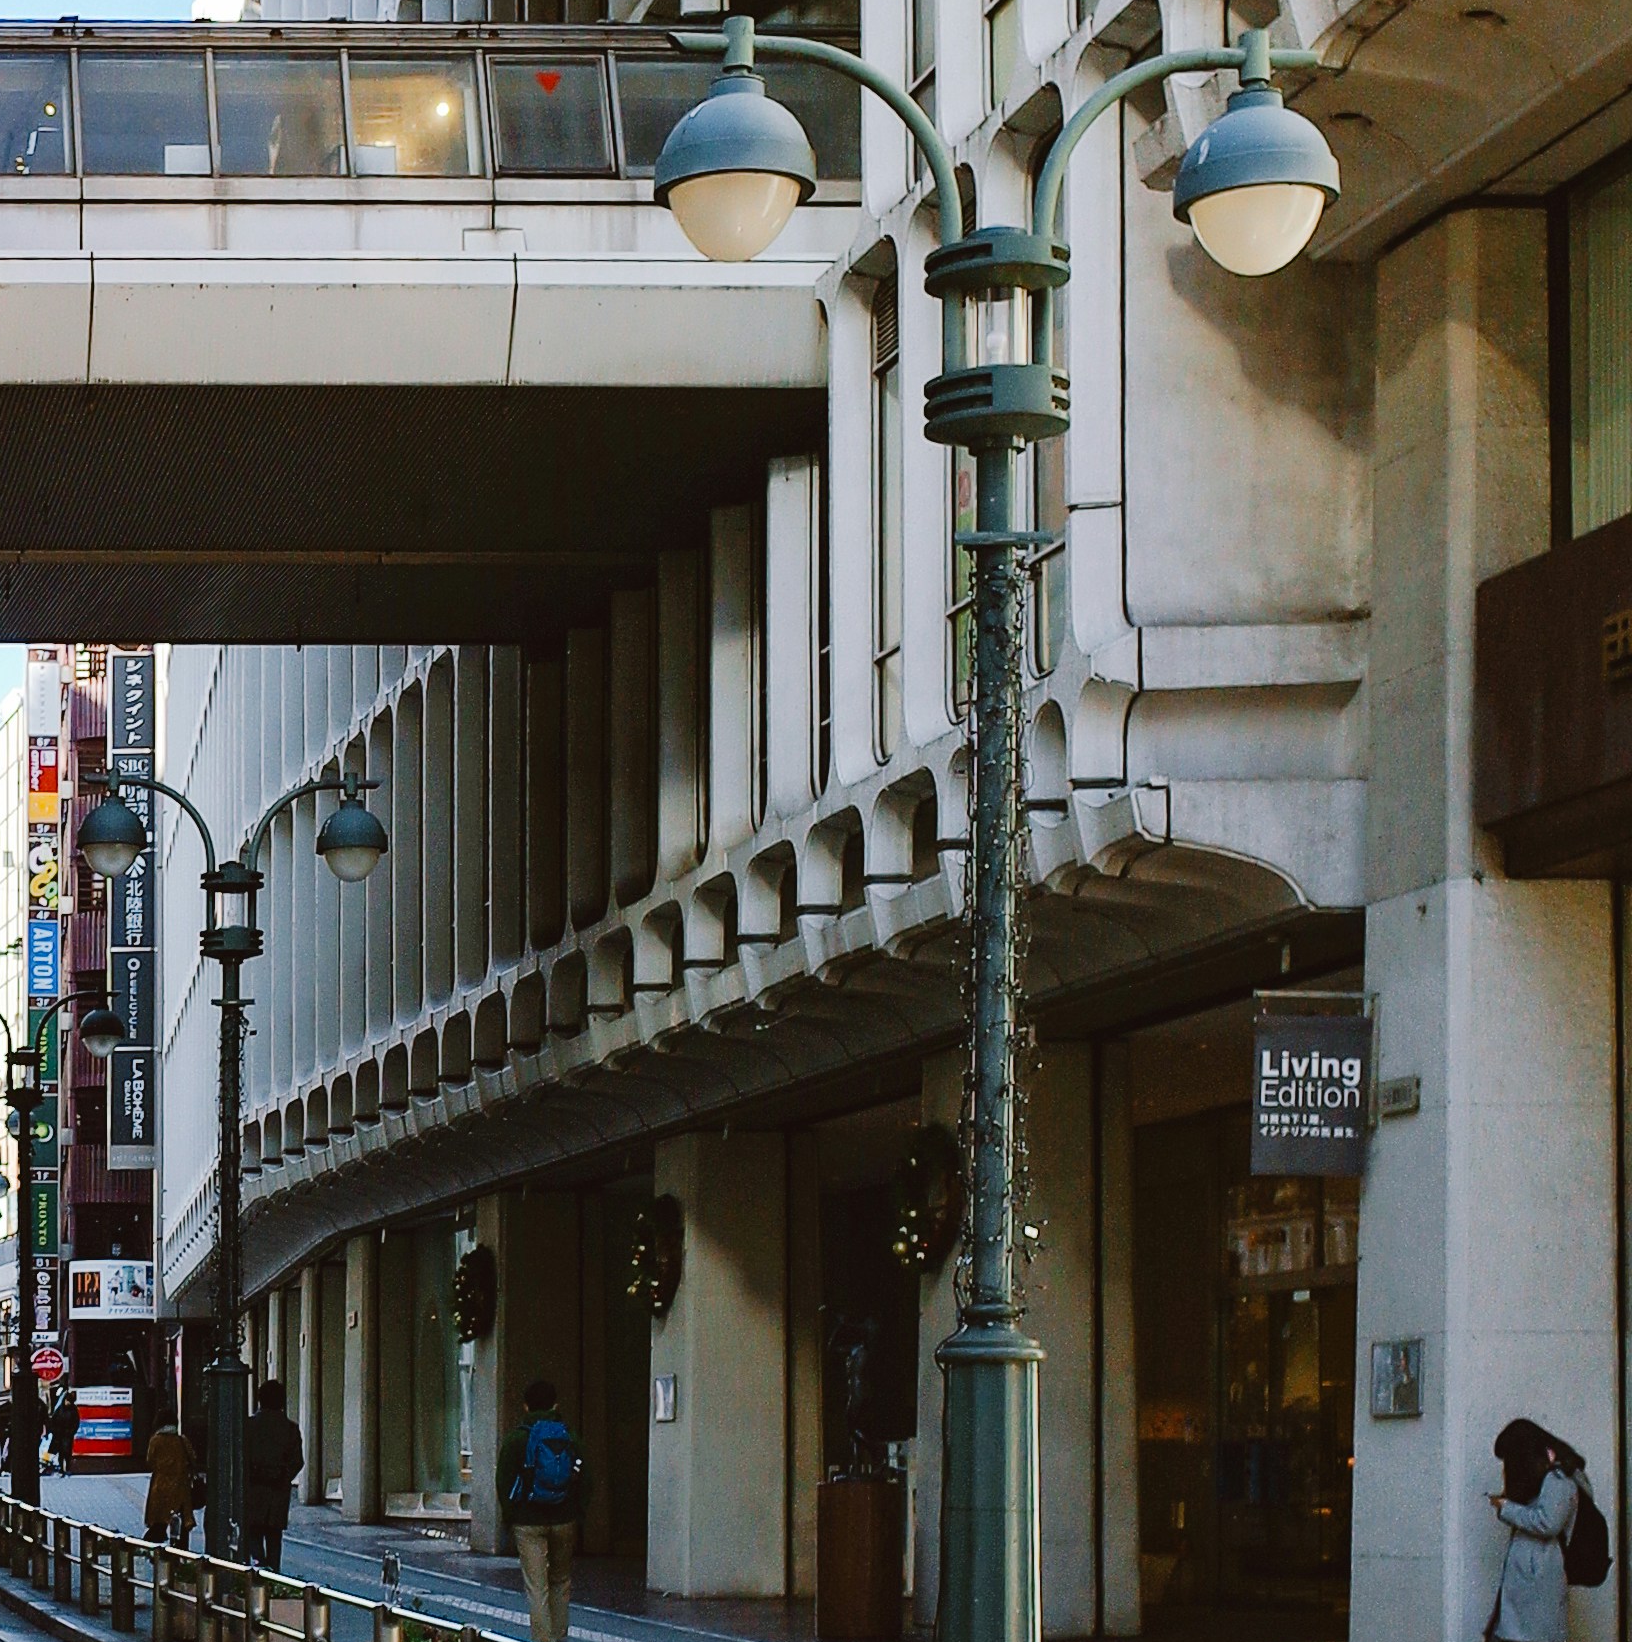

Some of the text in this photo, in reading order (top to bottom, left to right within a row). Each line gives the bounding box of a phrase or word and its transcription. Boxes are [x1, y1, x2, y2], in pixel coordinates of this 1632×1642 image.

[125, 659, 144, 745] シネクイント
[118, 758, 149, 773] SBC
[125, 880, 143, 945] 北陸銀行
[32, 927, 53, 990] ARTON
[132, 1059, 144, 1078] LA
[1261, 1050, 1361, 1086] Living
[1260, 1079, 1360, 1107] Edition
[39, 1193, 47, 1246] PRONTO
